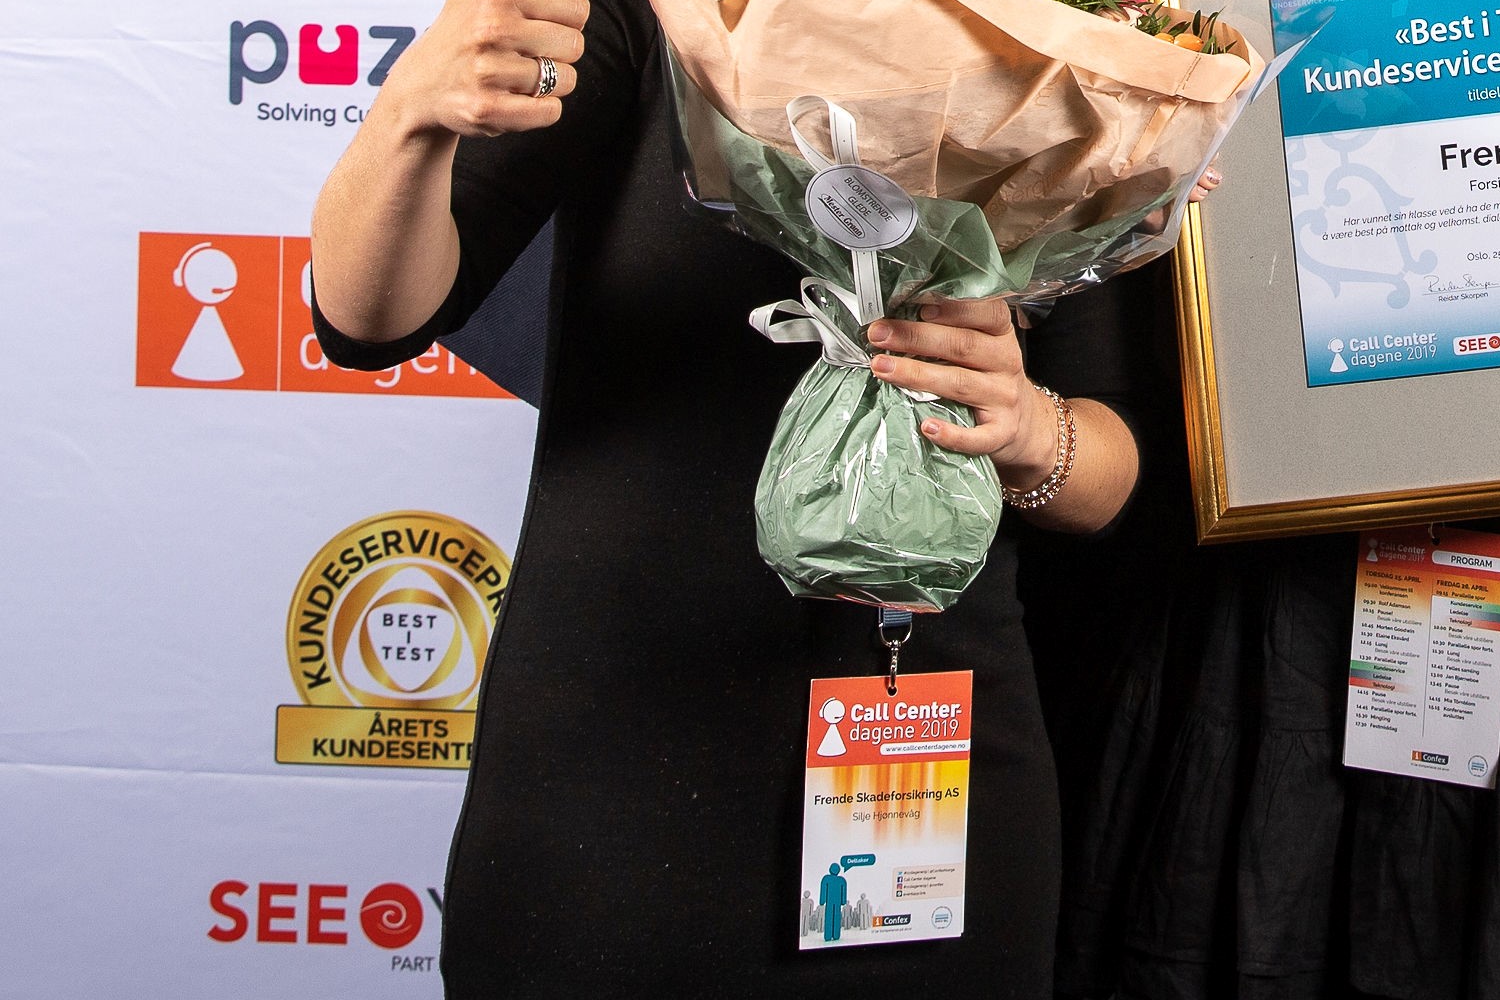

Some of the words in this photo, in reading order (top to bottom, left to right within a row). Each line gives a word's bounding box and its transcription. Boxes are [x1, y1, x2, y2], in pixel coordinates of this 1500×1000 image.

[1395, 15, 1475, 45] «Best
[1481, 10, 1490, 37] i
[257, 103, 337, 127] Solving
[824, 195, 844, 218] Mester
[843, 177, 893, 222] BLOMSTRENDE
[847, 196, 872, 217] GLEDE
[1343, 217, 1361, 226] Har
[1362, 214, 1392, 225] vunnet
[1394, 212, 1407, 221] sin
[1409, 208, 1437, 219] klasse
[1439, 206, 1456, 216] ved
[1457, 205, 1464, 214] å
[1466, 203, 1479, 213] ha
[1480, 201, 1492, 211] de
[1322, 233, 1329, 241] å
[1331, 231, 1353, 240] være
[1355, 227, 1374, 237] best
[1376, 226, 1388, 237] på
[1390, 222, 1423, 233] mottak
[1424, 222, 1436, 231] og
[1438, 292, 1459, 302] Reidar
[1461, 291, 1489, 301] Skorpen
[1350, 336, 1379, 352] Call
[1458, 338, 1487, 352] SEE
[1351, 348, 1403, 368] dagene
[1407, 344, 1437, 361] 2019
[1451, 555, 1493, 568] PROGRAM
[382, 613, 437, 629] BEST
[382, 647, 436, 662] TEST
[850, 702, 890, 722] Call
[368, 712, 449, 738] ÅRETS
[850, 723, 915, 745] dagene
[921, 719, 959, 738] 2019
[1422, 754, 1446, 764] Confex
[814, 793, 854, 805] Frende
[856, 789, 943, 802] Skadeforsikring
[944, 788, 960, 798] AS
[852, 811, 871, 822] Silje
[207, 879, 348, 945] SEE
[883, 916, 909, 925] Confex
[392, 956, 435, 972] PART
